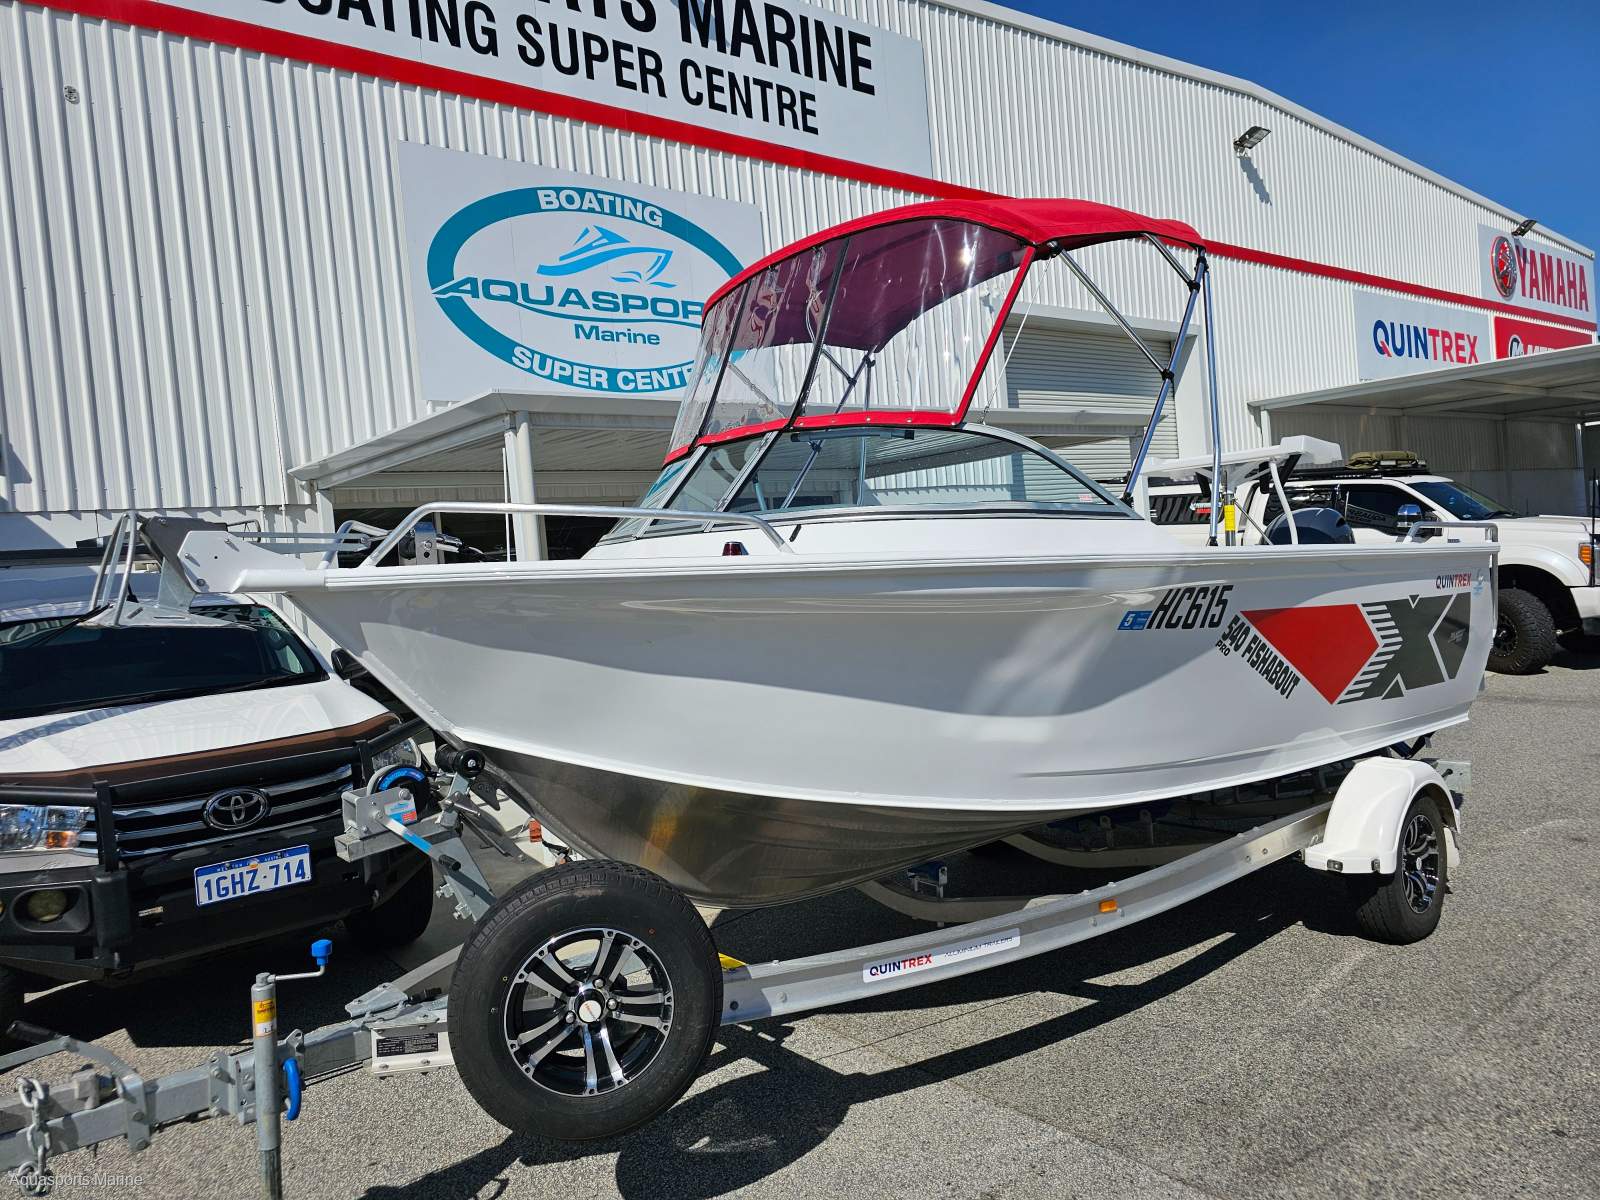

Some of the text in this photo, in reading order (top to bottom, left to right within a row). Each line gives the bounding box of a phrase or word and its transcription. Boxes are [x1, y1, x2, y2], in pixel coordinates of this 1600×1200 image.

[263, 0, 499, 57] TING
[515, 13, 668, 99] SUPER
[679, 58, 820, 136] CENTRE
[679, 0, 876, 97] MARINE
[536, 189, 664, 228] BOATING
[431, 276, 705, 320] AQUASPOR
[1515, 244, 1590, 313] YAMAHA
[574, 323, 661, 346] Marine
[1372, 319, 1479, 365] QUINTREX
[511, 346, 695, 392] SUPER CENT
[1435, 573, 1472, 590] QUINTREX
[1146, 585, 1234, 630] HC615
[1215, 639, 1231, 657] PRO
[1221, 614, 1301, 700] 540 FISHABOUT
[869, 953, 933, 977] QUINTREX
